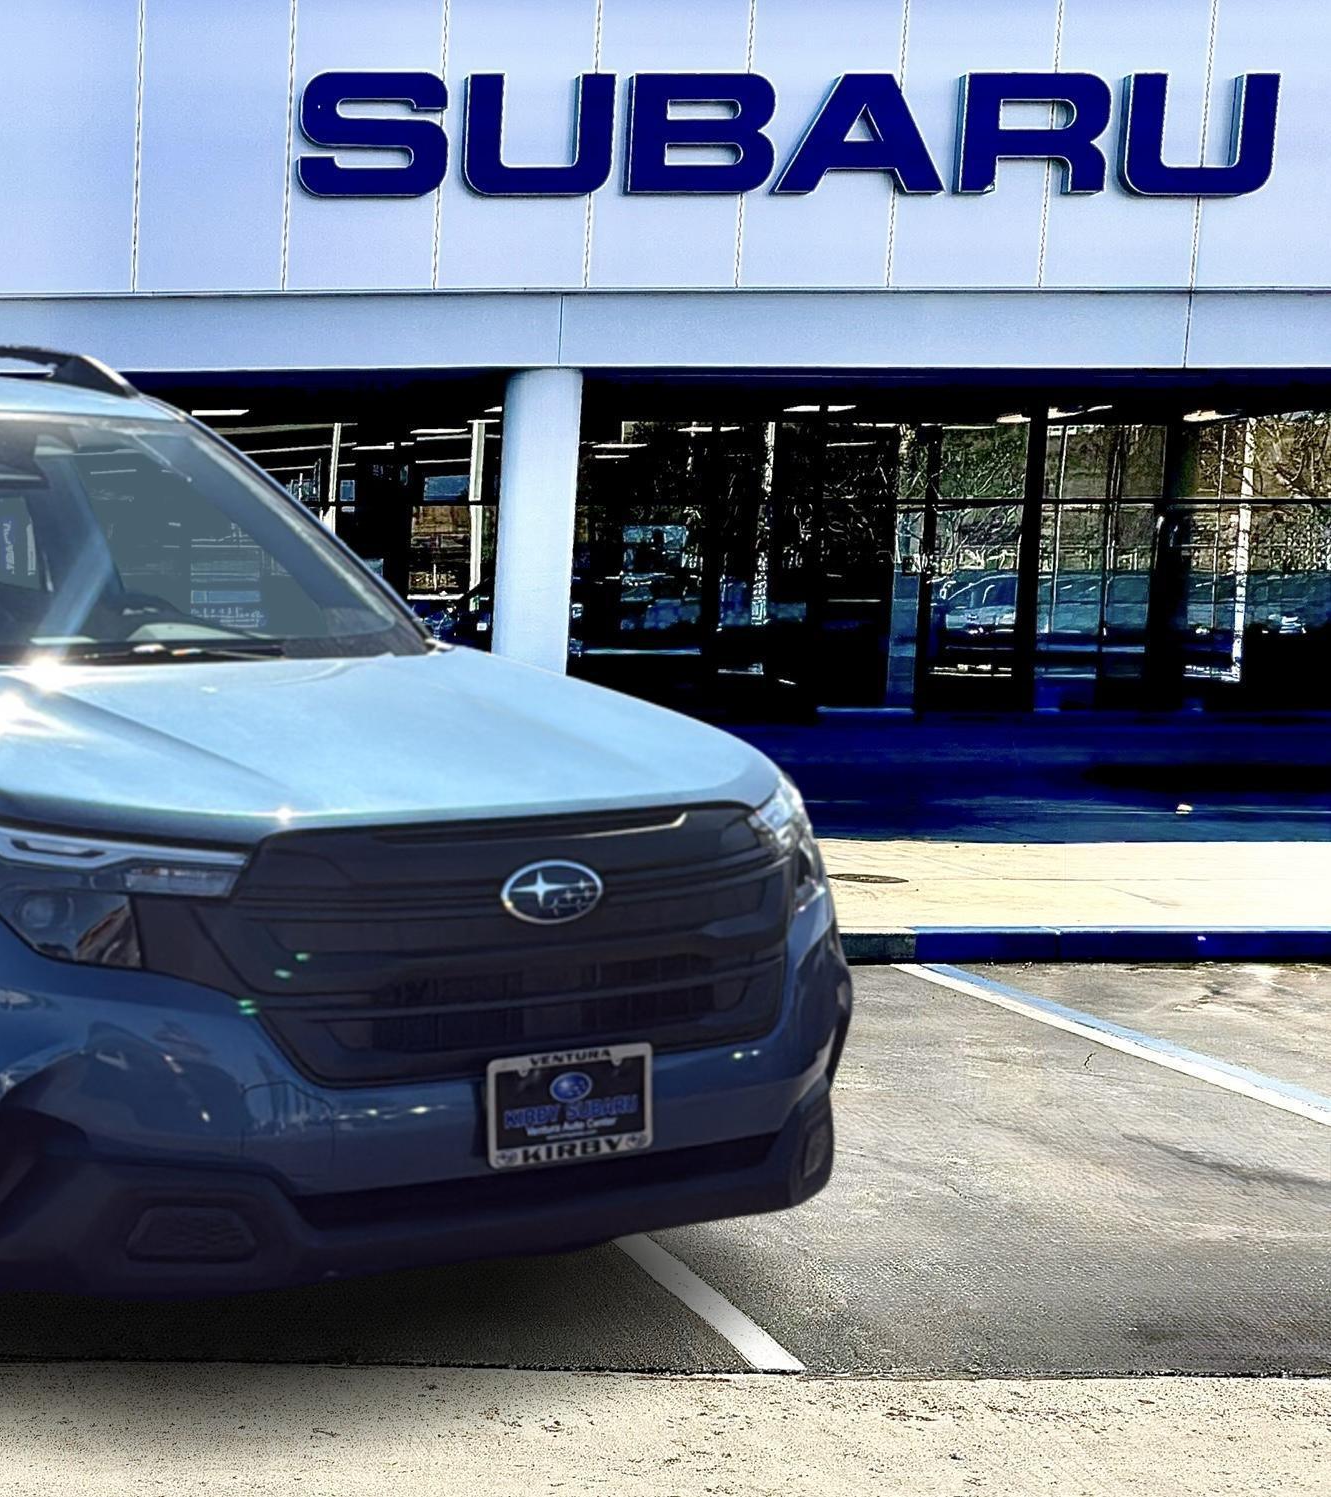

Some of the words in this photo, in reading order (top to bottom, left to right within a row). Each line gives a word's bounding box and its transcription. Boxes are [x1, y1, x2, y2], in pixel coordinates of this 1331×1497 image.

[296, 71, 1281, 198] SUBARU
[530, 1050, 611, 1065] VENTURA
[504, 1107, 559, 1128] KIRBY
[567, 1095, 637, 1120] SUBARU
[526, 1126, 560, 1136] Ventura
[563, 1122, 585, 1130] Auto
[587, 1118, 616, 1128] Center
[524, 1139, 622, 1162] KIRBY
